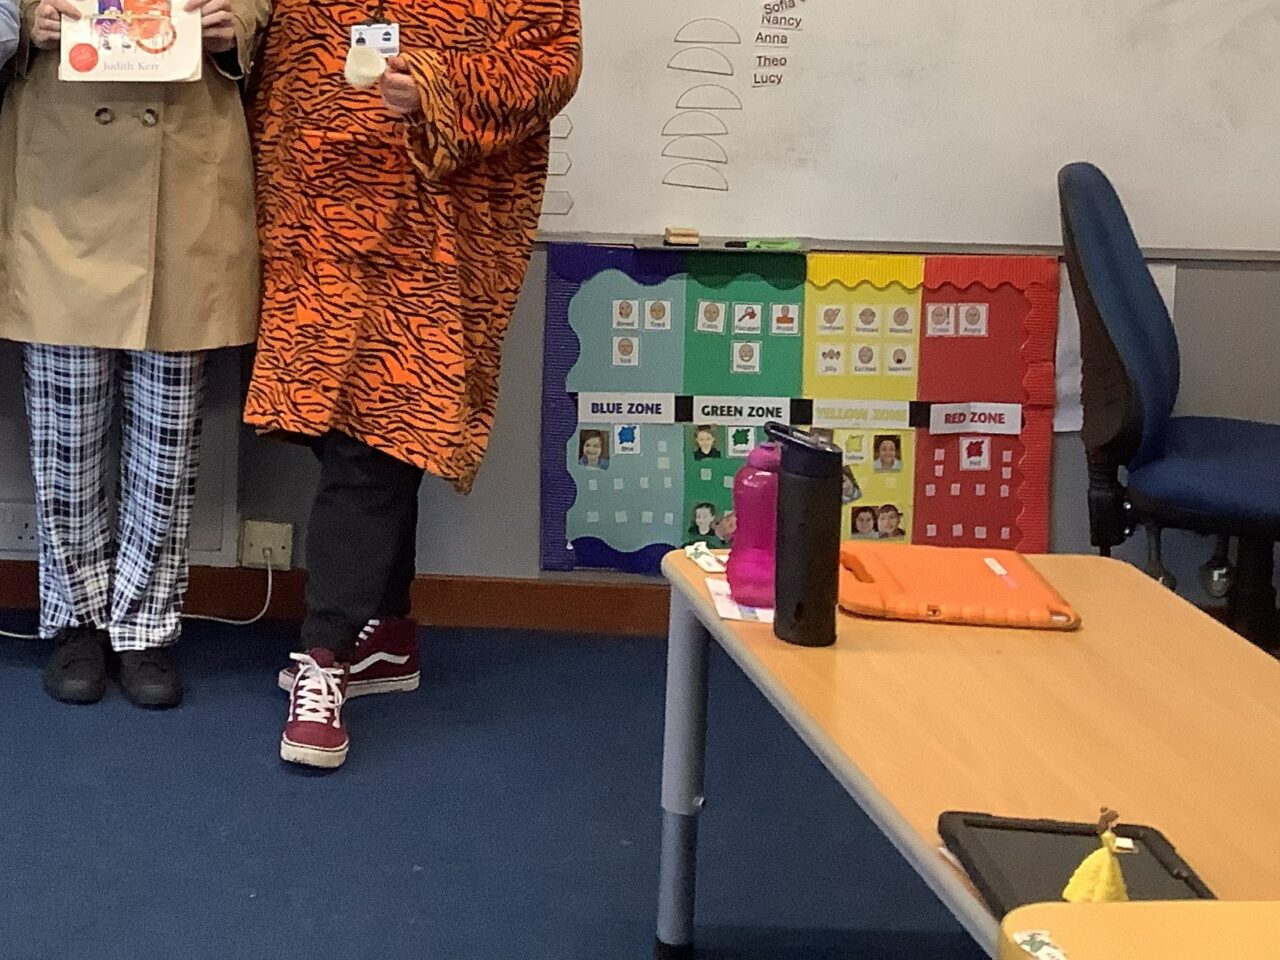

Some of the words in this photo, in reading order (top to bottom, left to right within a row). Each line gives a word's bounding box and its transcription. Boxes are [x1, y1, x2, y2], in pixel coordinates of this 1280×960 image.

[761, 14, 802, 29] Nancy
[755, 32, 788, 44] Anna
[103, 61, 135, 72] Judith
[137, 61, 160, 71] Kerr
[756, 55, 787, 67] Theo
[753, 73, 783, 86] Lucy
[591, 402, 623, 415] BLUE
[627, 403, 662, 415] ZONE
[701, 405, 743, 417] GREEN
[747, 406, 783, 418] ZONE
[944, 413, 967, 424] RED
[969, 412, 1006, 424] ZONE
